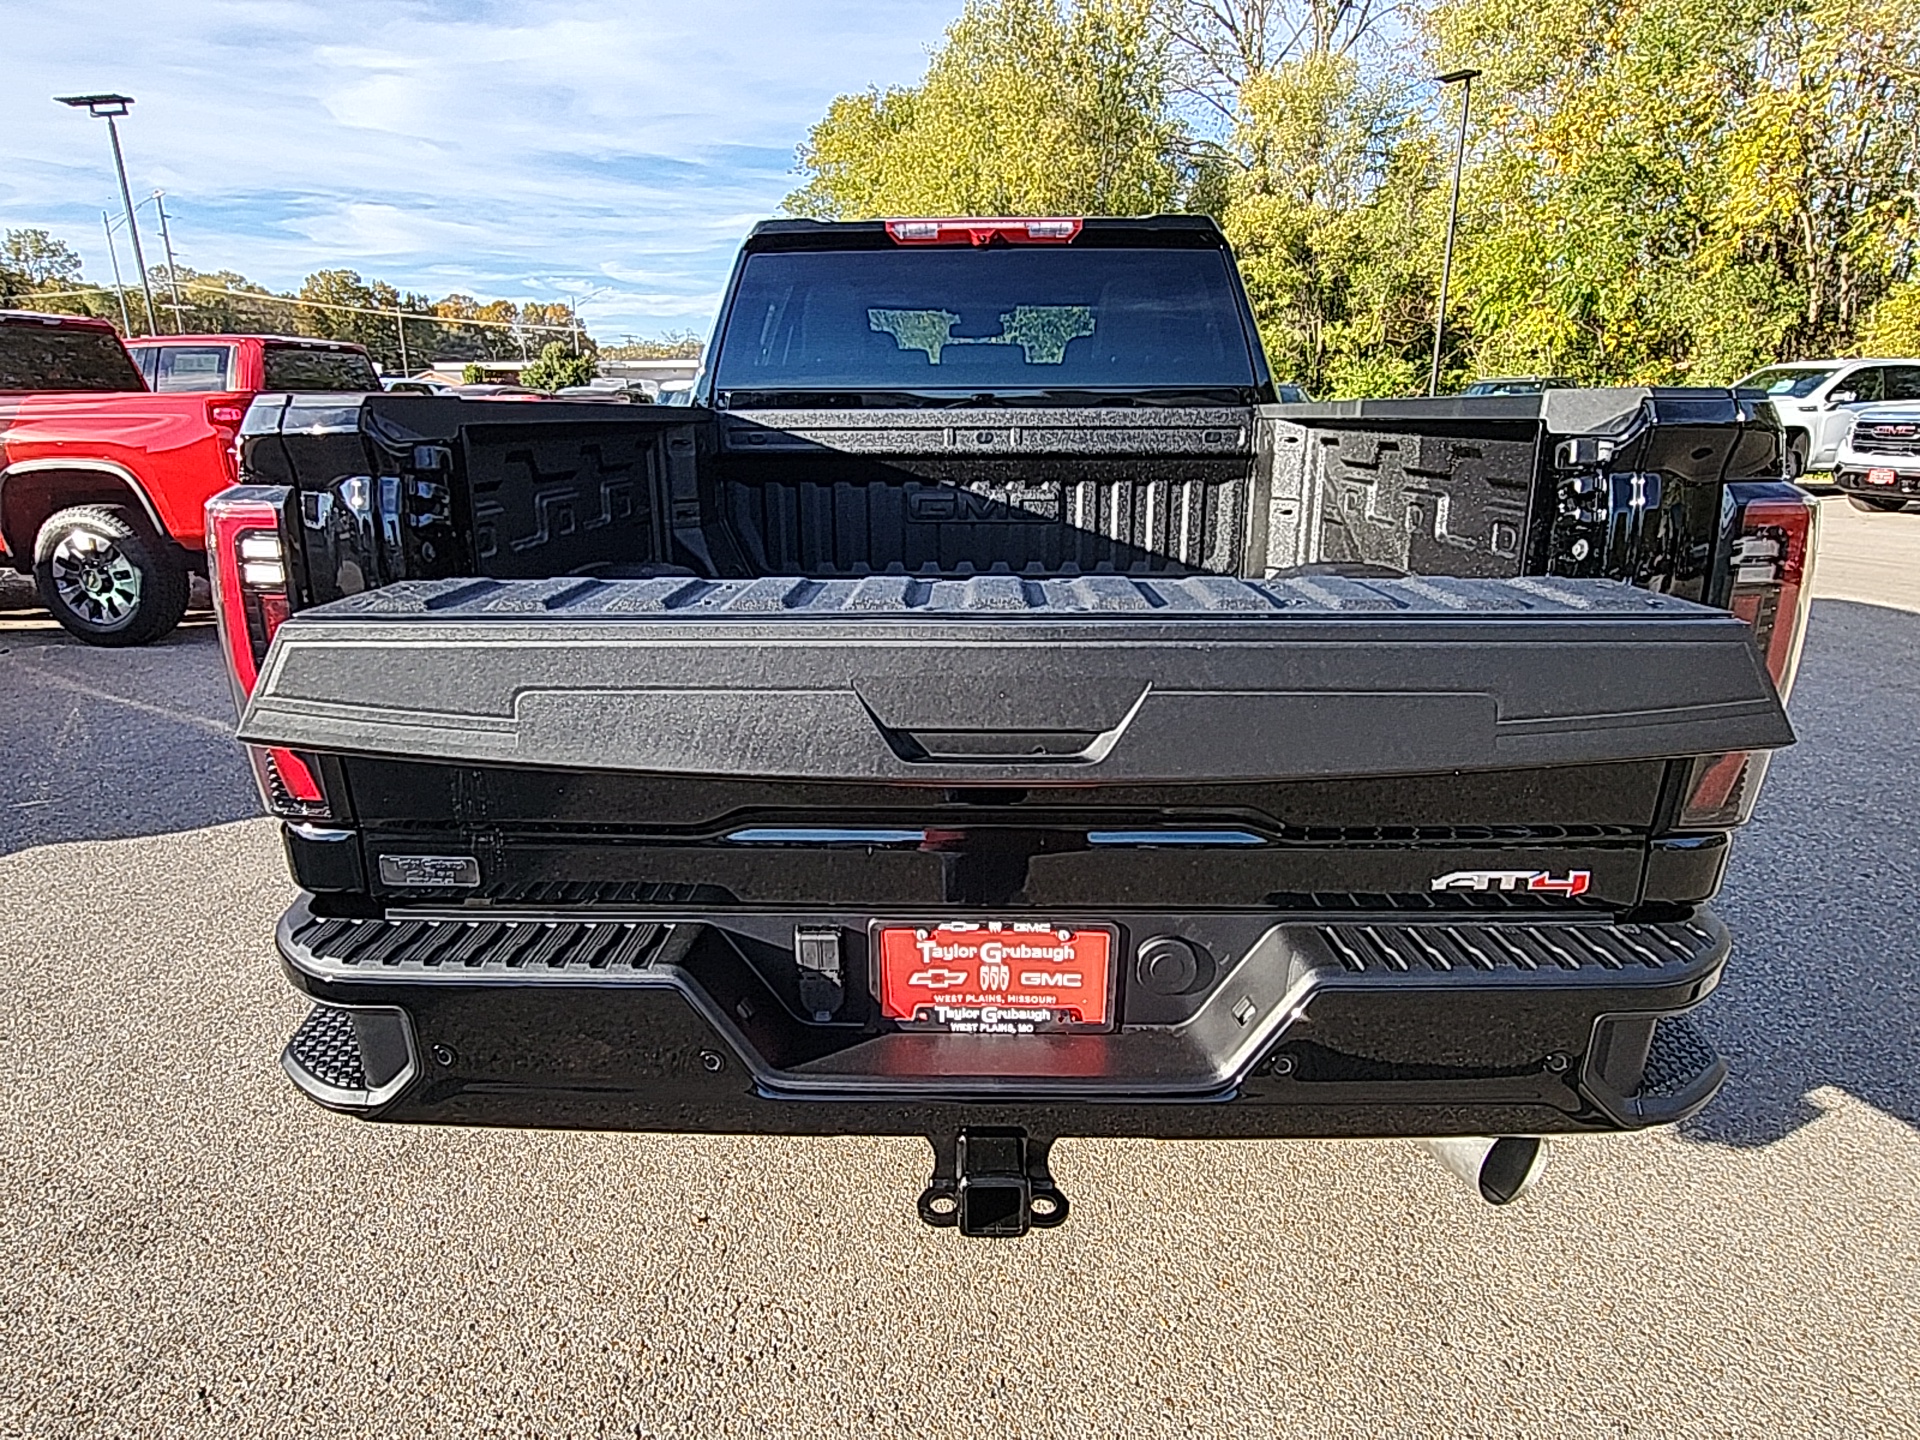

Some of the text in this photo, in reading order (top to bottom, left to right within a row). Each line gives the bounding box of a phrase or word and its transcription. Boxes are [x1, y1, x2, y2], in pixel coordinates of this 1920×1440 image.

[910, 492, 1058, 521] GMC
[1431, 871, 1591, 897] AT4
[1013, 922, 1051, 933] GMC
[916, 941, 1075, 964] Taylor Grubaugh
[1020, 972, 1082, 987] GMC
[934, 994, 1057, 1004] WEST PLAINS, MISSOURI
[935, 1005, 1051, 1023] Taylor Grubaugh
[950, 1023, 979, 1032] WEST
